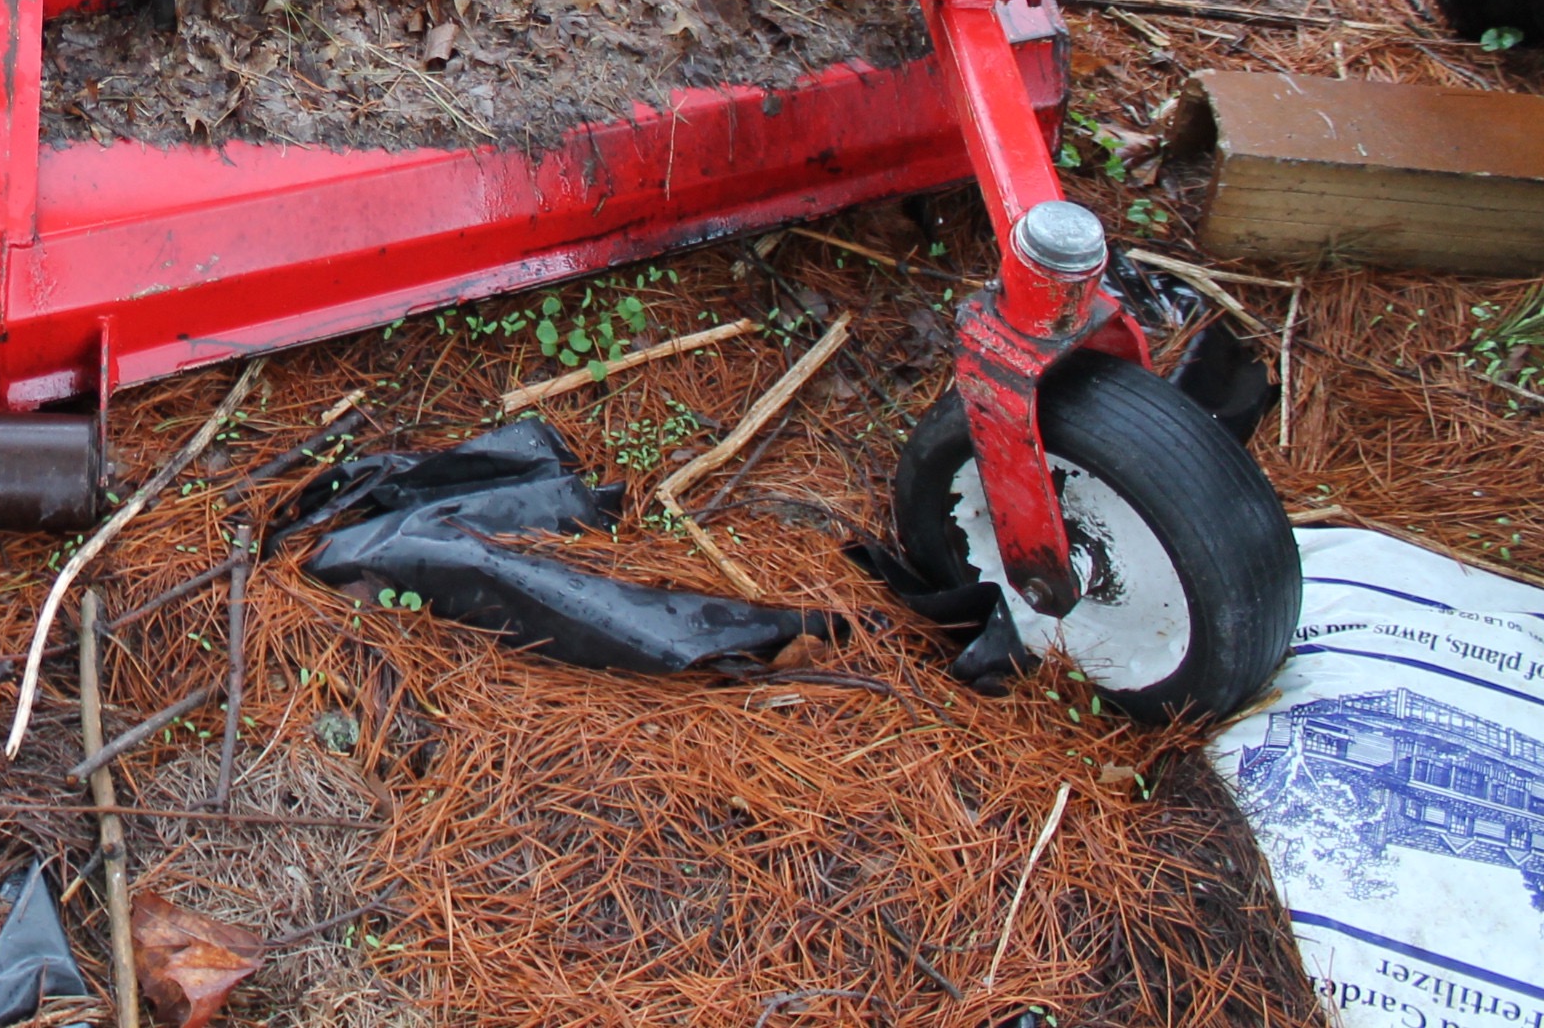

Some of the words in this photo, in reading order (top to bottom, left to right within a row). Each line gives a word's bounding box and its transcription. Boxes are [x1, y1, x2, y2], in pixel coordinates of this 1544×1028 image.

[1292, 623, 1320, 642] sh
[1483, 615, 1504, 628] LB
[1373, 623, 1440, 652] lawns
[1445, 633, 1523, 674] plants,
[1375, 957, 1544, 1028] Fertilizer
